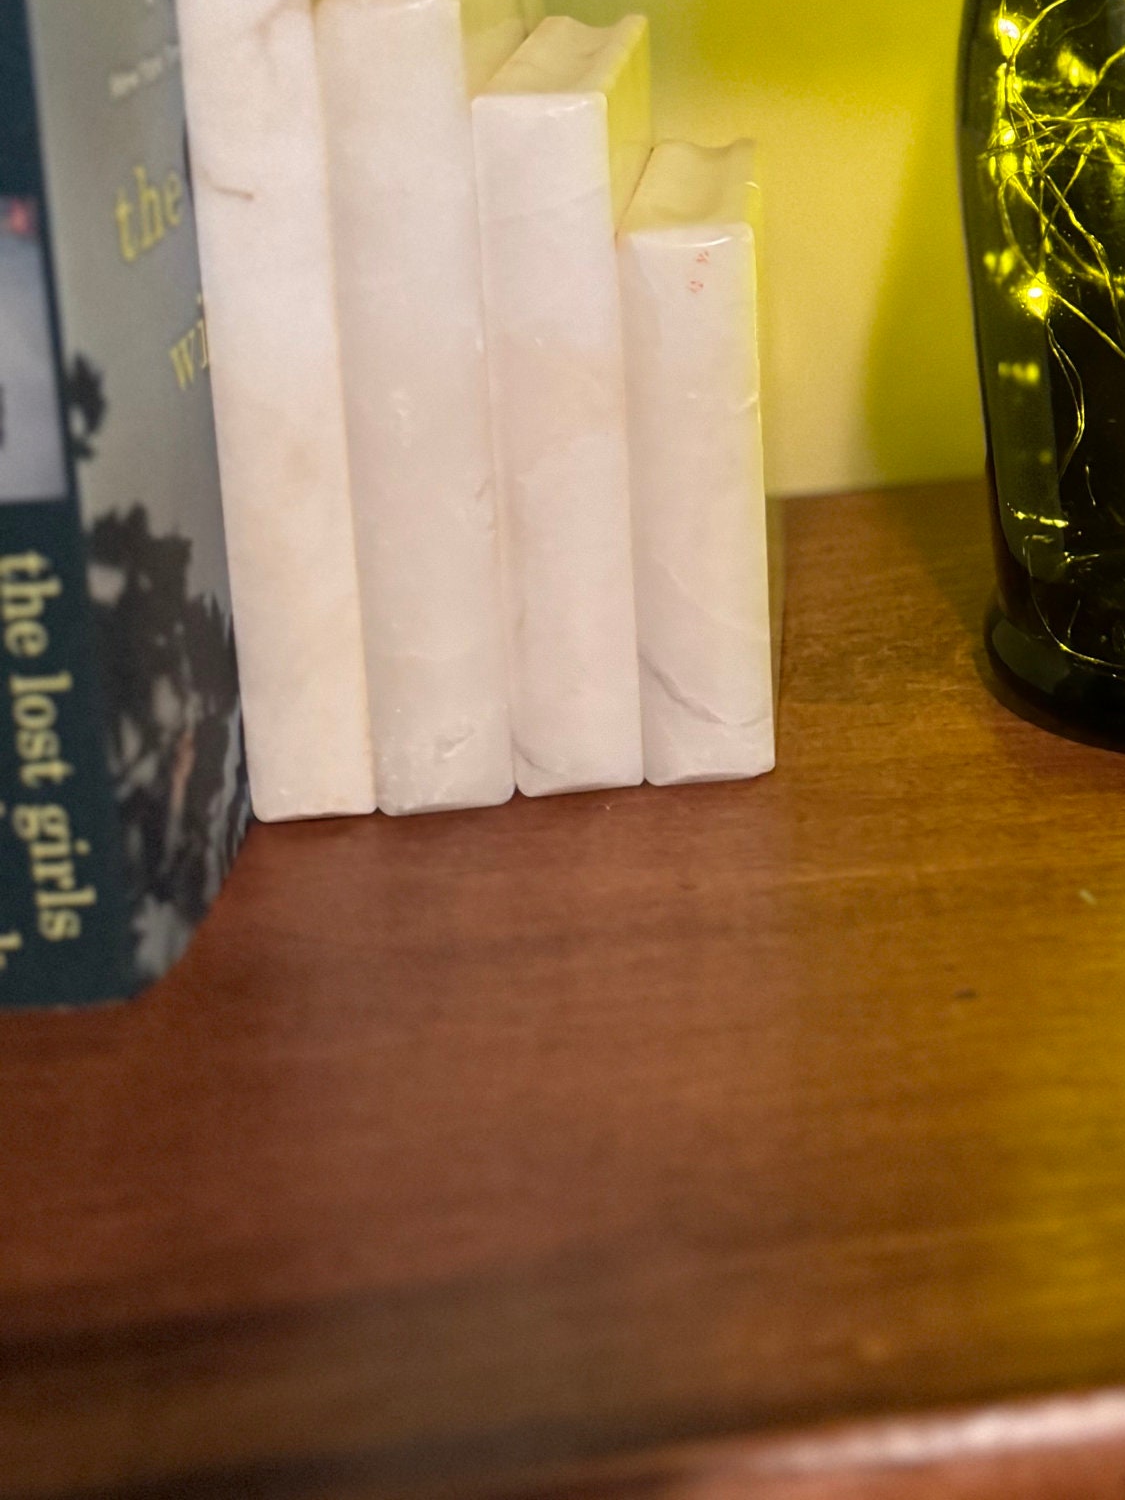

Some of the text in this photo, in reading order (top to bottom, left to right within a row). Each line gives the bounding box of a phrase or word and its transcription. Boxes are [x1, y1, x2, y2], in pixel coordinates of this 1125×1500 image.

[114, 164, 184, 263] the
[0, 548, 97, 943] the lost girls
